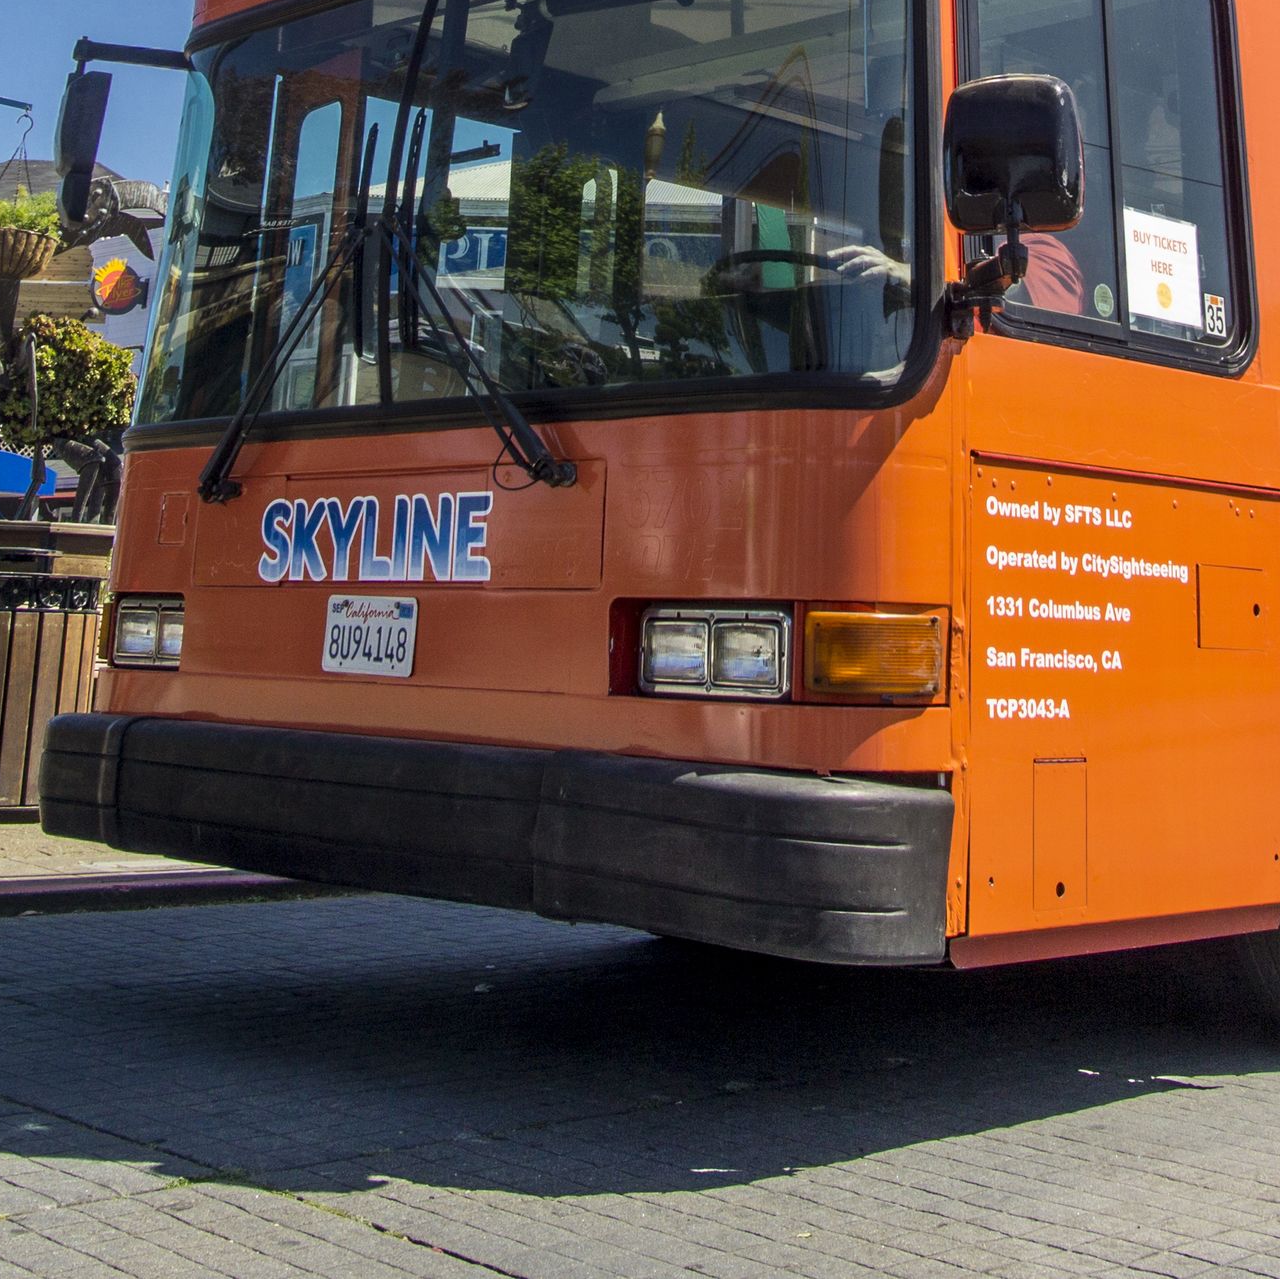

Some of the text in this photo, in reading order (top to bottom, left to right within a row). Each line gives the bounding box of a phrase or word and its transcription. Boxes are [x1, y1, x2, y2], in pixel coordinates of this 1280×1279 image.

[1133, 230, 1188, 255] BUY TICKETS
[1150, 259, 1174, 277] HERE
[1207, 304, 1224, 334] 35
[986, 496, 1132, 528] Owned by SFTS LLC
[258, 491, 494, 583] SKYLINE
[986, 545, 1189, 584] Operated by CitySightseeing
[345, 601, 400, 624] California
[986, 596, 1131, 622] 1331 Columbus Ave
[329, 624, 407, 663] 8U94148
[986, 647, 1122, 673] San Francisco, CA
[986, 698, 1071, 719] TCP3043-A
